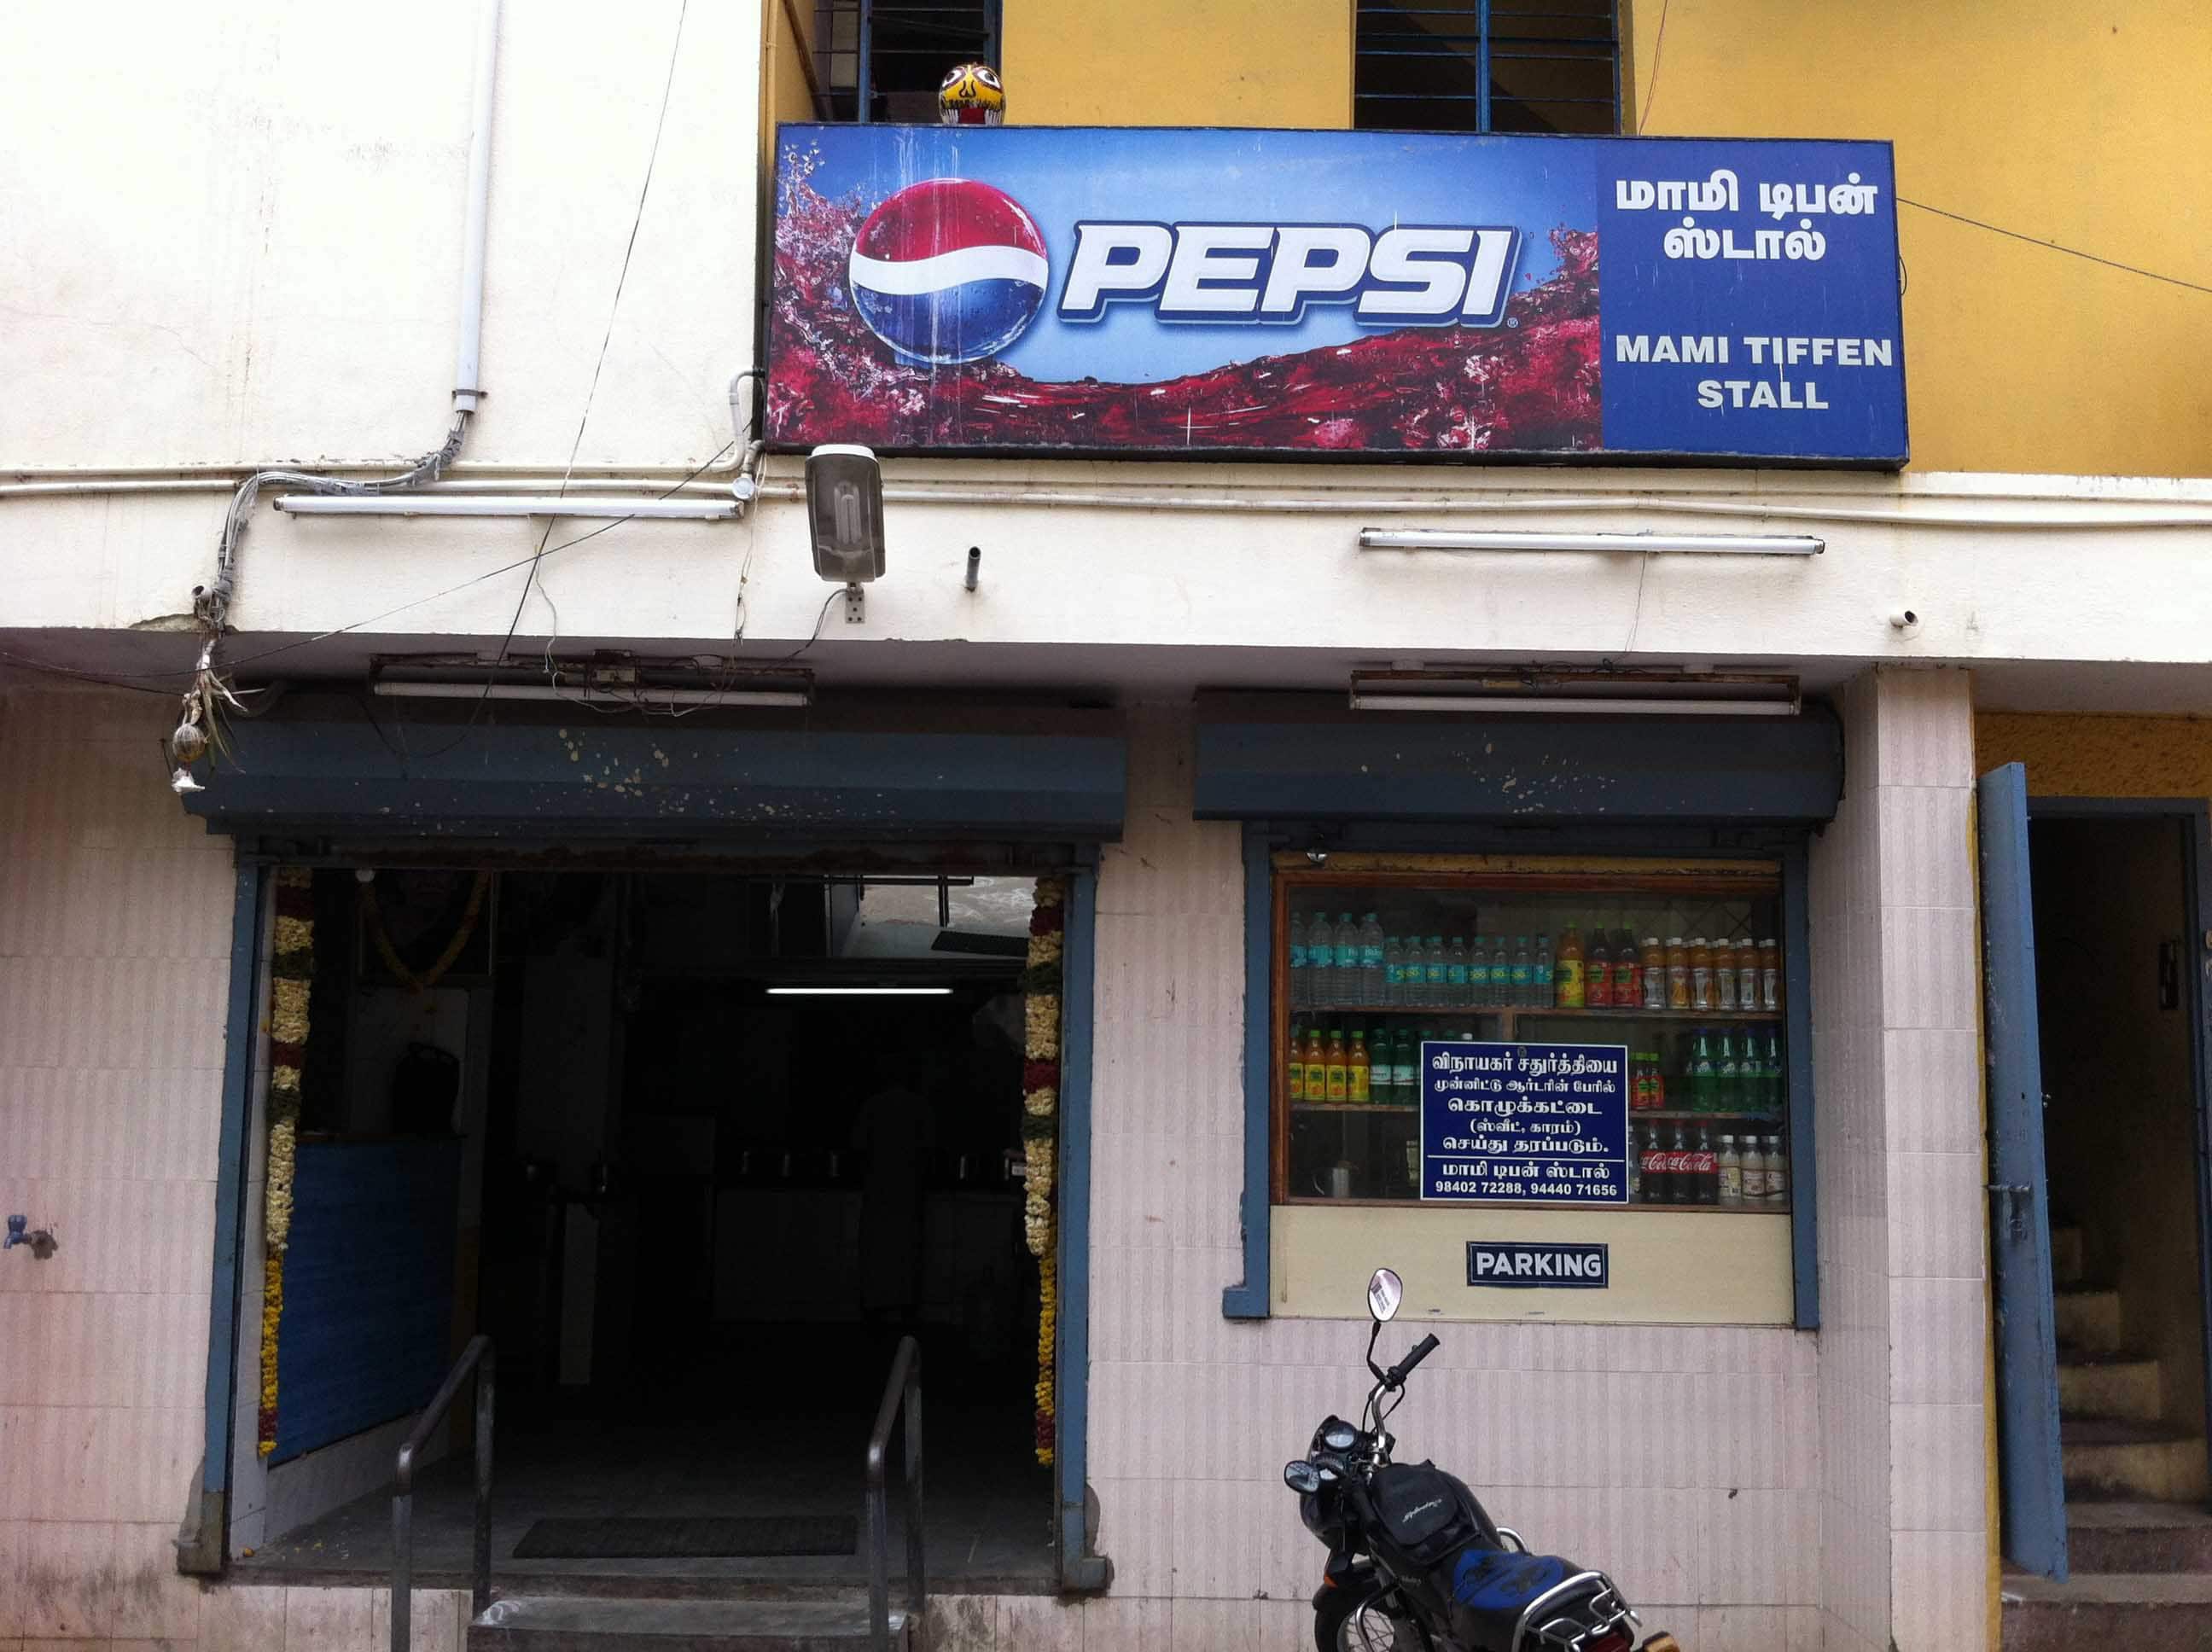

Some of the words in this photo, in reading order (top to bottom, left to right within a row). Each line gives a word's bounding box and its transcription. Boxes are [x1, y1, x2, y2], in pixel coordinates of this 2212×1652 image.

[1616, 169, 1739, 212] மாமி
[1759, 172, 1878, 220] டிபன்
[1663, 217, 1826, 260] ஸ்டால்
[1058, 222, 1521, 328] PEPSI
[1616, 334, 1729, 364] MAMI
[1743, 337, 1893, 366] TIFFEN
[1697, 380, 1830, 410] STALL
[1432, 1050, 1513, 1074] விநாயகர்
[1442, 1134, 1508, 1154] செய்து
[1442, 1160, 1487, 1176] மாமி
[1493, 1160, 1540, 1180] டிபன்
[1545, 1161, 1610, 1179] ஸ்டால்
[1435, 1180, 1476, 1193] 98402
[1481, 1181, 1526, 1196] 72288,
[1530, 1183, 1572, 1195] 94440
[1577, 1184, 1617, 1196] 71656
[1476, 1252, 1602, 1277] PARKING
